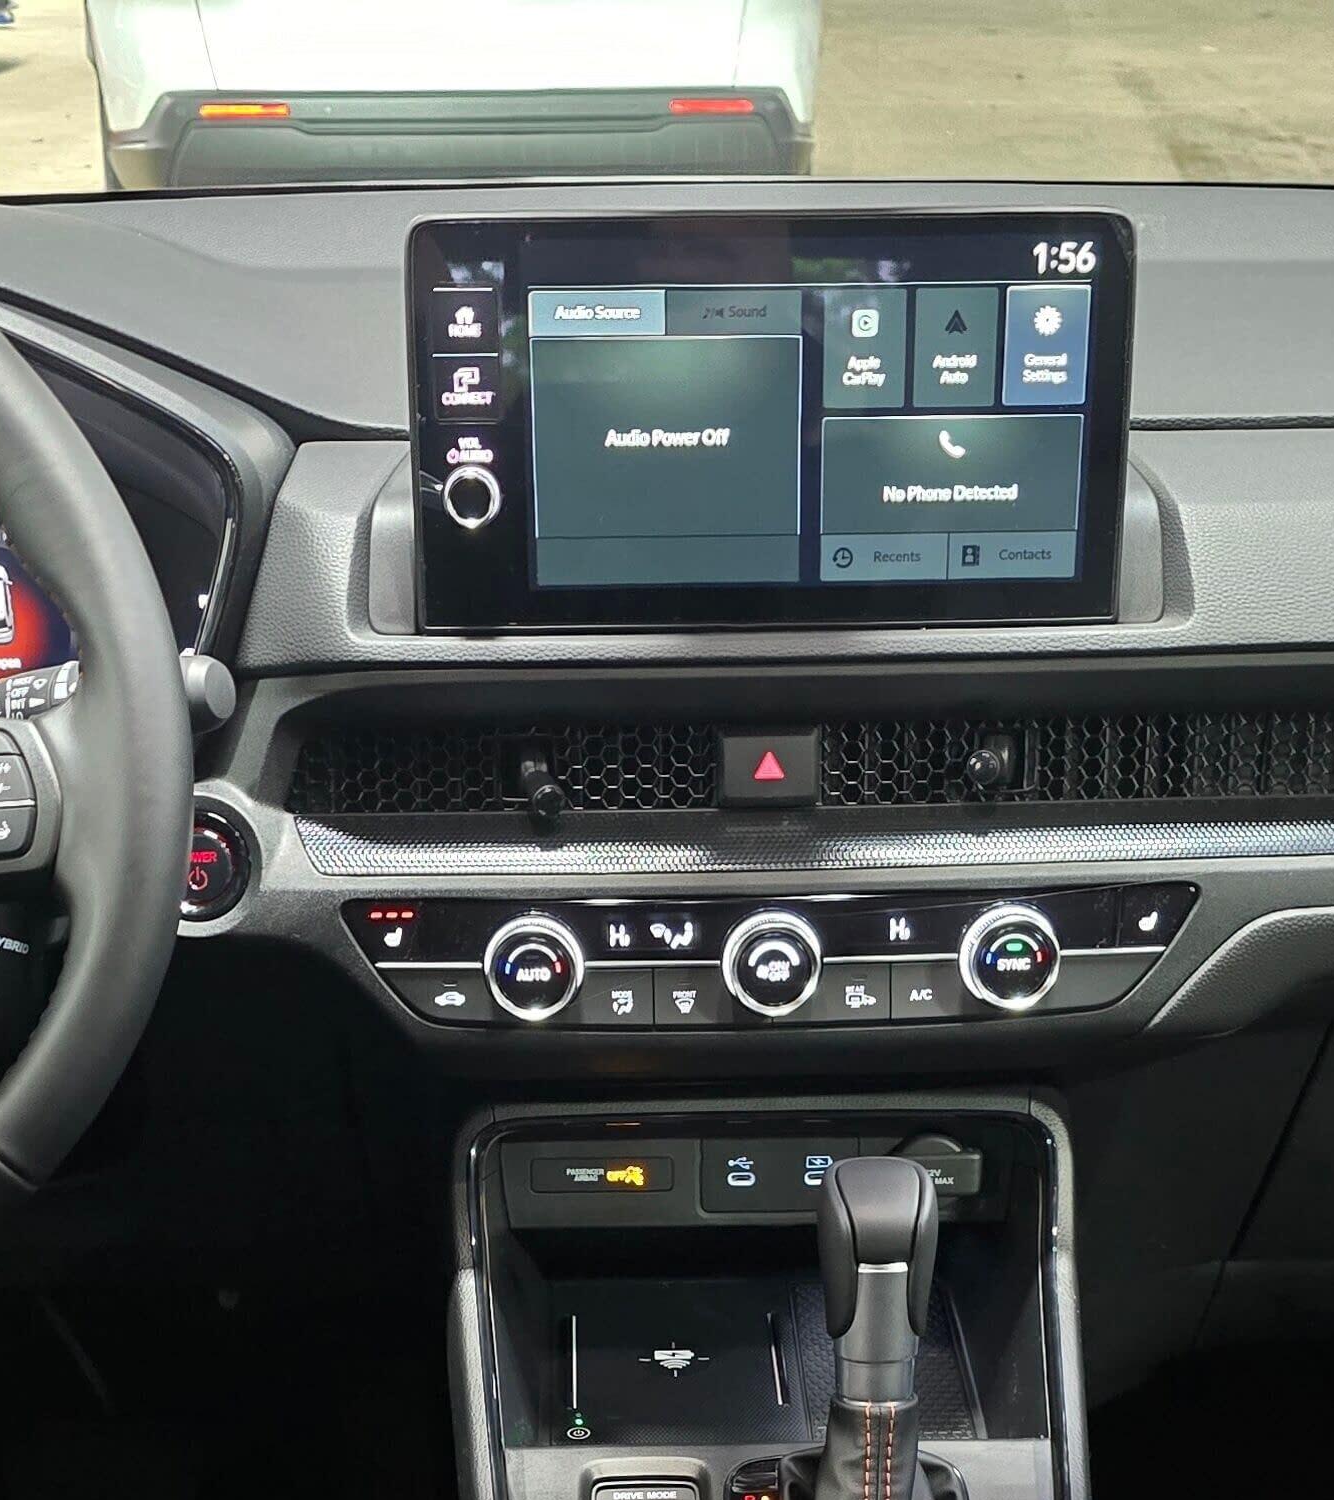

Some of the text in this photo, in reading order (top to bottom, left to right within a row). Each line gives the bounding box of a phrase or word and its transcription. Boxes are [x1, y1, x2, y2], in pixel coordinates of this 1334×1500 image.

[1032, 241, 1096, 274] 1:56
[554, 305, 641, 320] Audio Source
[728, 305, 767, 318] Sound
[847, 355, 881, 371] Apple
[932, 354, 978, 369] Android
[1023, 353, 1068, 367] General
[939, 371, 969, 385] Auto
[604, 428, 731, 448] Audio Power Off
[882, 483, 1018, 502] No Phone Detected
[873, 550, 921, 563] Recents
[998, 548, 1052, 561] Contacts
[190, 851, 217, 863] WER
[996, 957, 1032, 972] SYNC
[515, 967, 552, 982] AUTO
[909, 988, 934, 1002] A/C
[928, 1169, 942, 1177] 2V
[934, 1177, 955, 1185] MAX
[613, 1490, 677, 1500] DRIVE MODE
